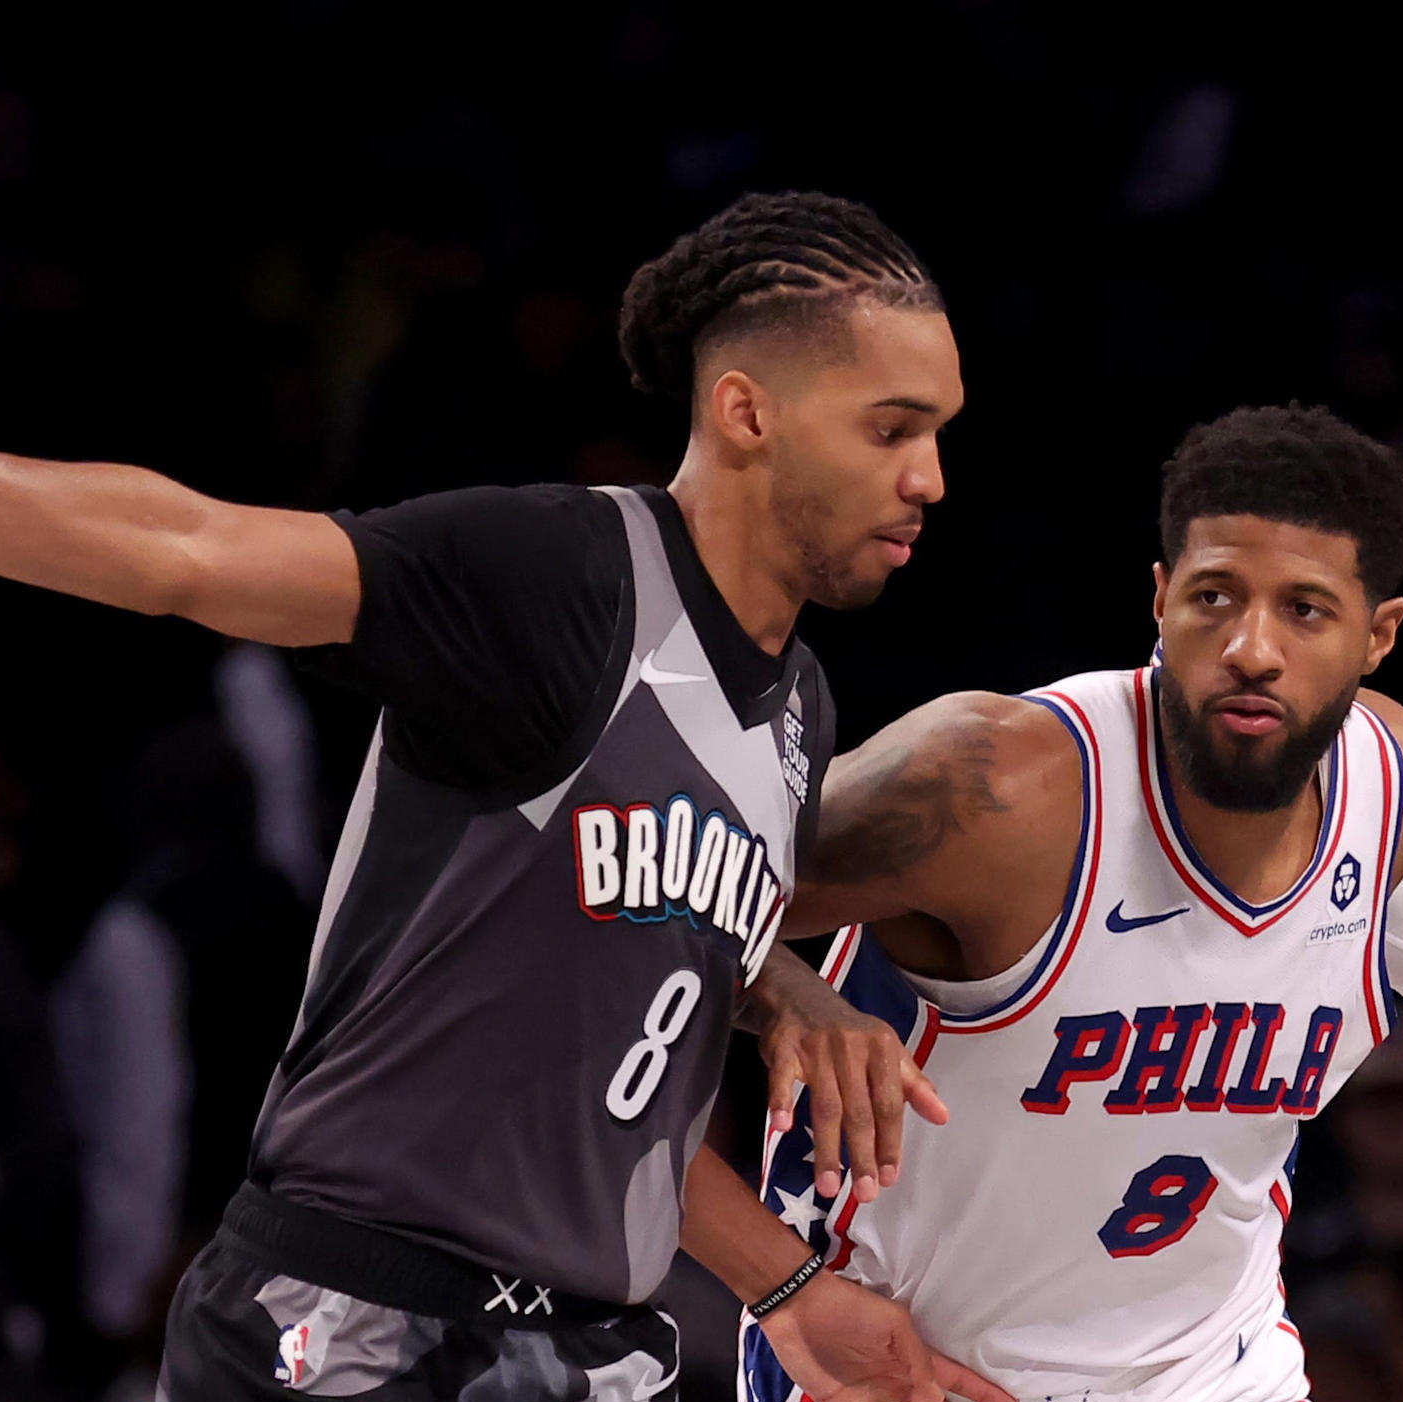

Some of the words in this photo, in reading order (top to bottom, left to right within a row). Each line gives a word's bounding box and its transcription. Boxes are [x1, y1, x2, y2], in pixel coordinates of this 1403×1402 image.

[783, 711, 804, 746] GET
[783, 734, 809, 780] YOUR
[782, 757, 808, 805] GUIDE
[605, 969, 702, 1120] 8
[1020, 1001, 1343, 1116] PHILA
[1097, 1154, 1219, 1259] 8
